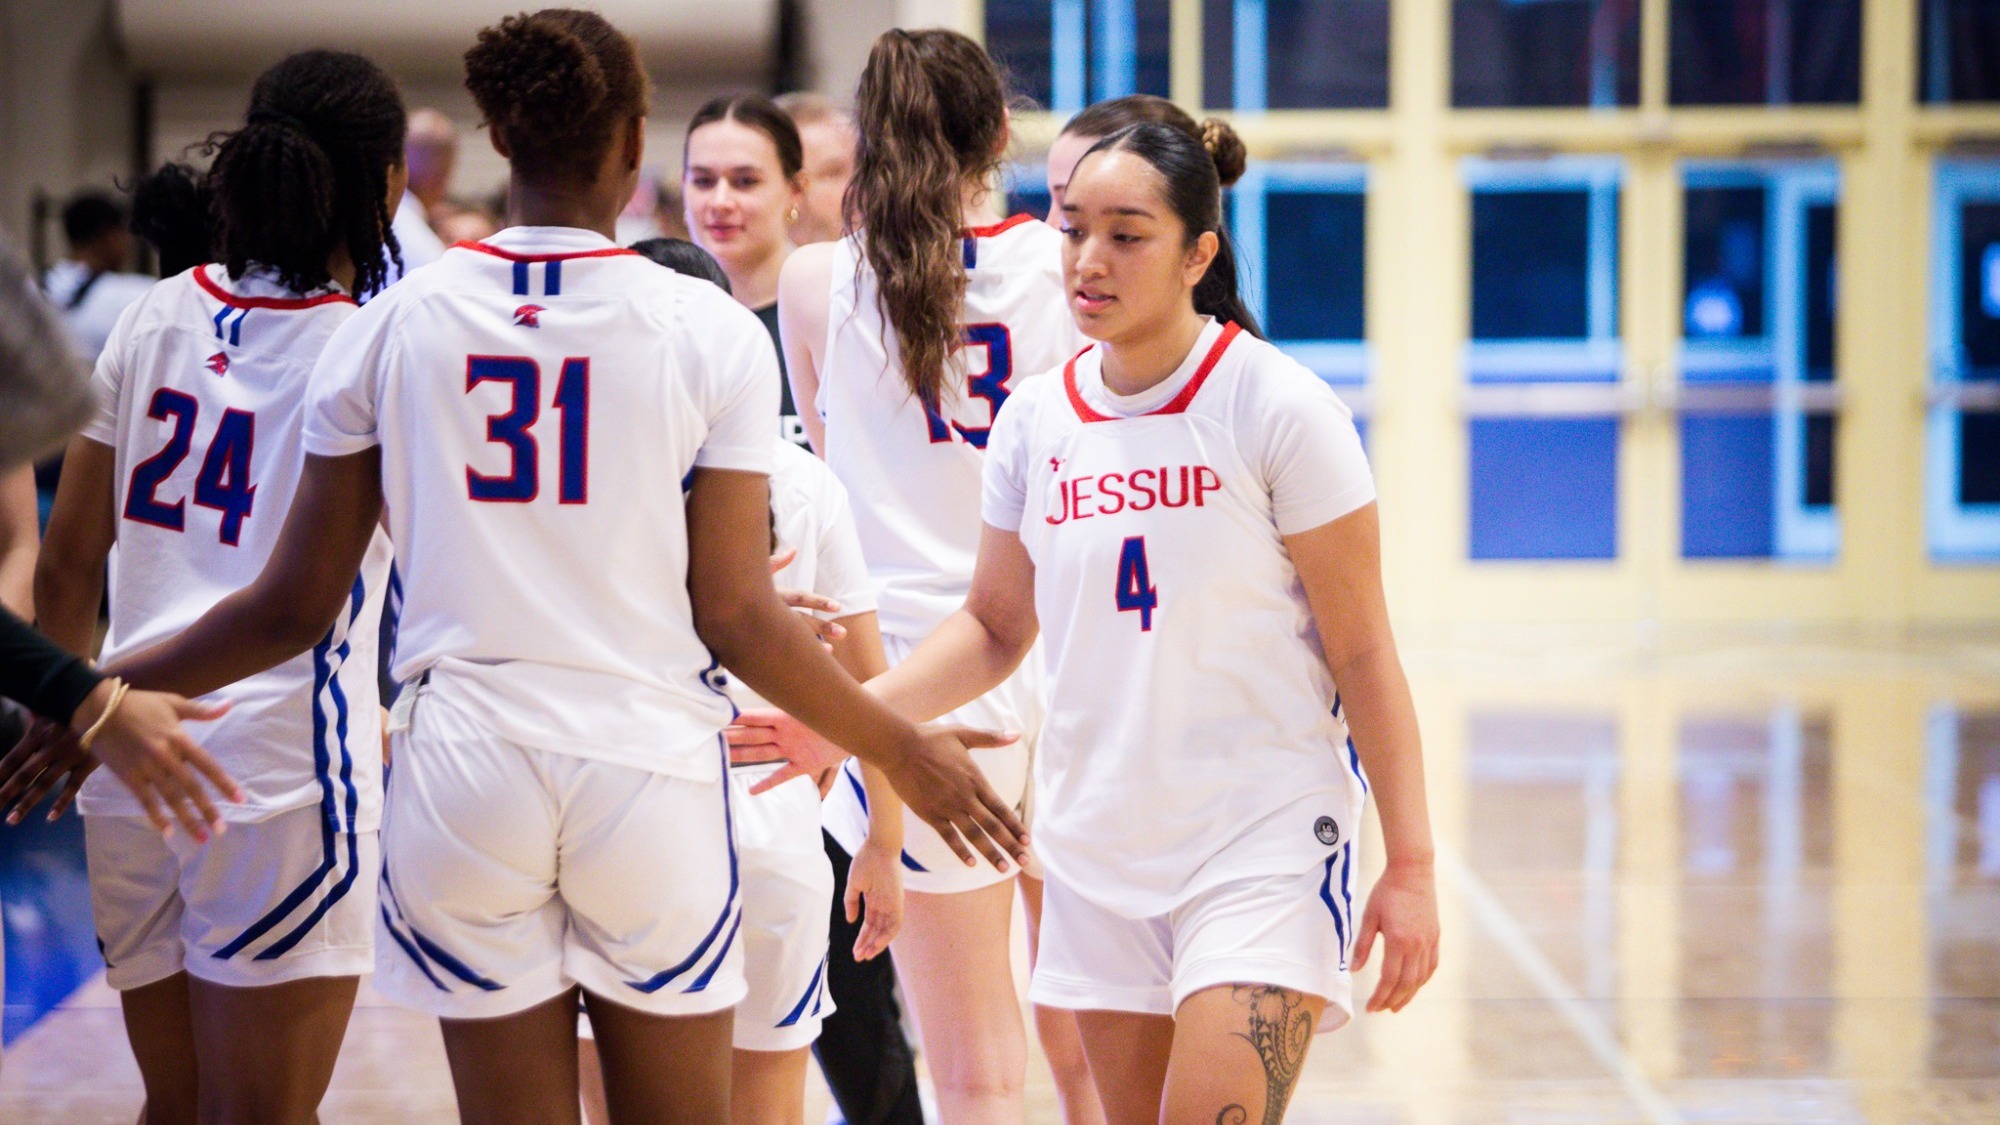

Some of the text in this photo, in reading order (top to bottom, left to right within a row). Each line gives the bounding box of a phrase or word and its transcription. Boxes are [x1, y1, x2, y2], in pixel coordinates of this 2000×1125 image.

[124, 387, 256, 546] 24
[466, 354, 590, 504] 31
[1045, 465, 1222, 525] JESSUP
[1115, 535, 1158, 632] 4
